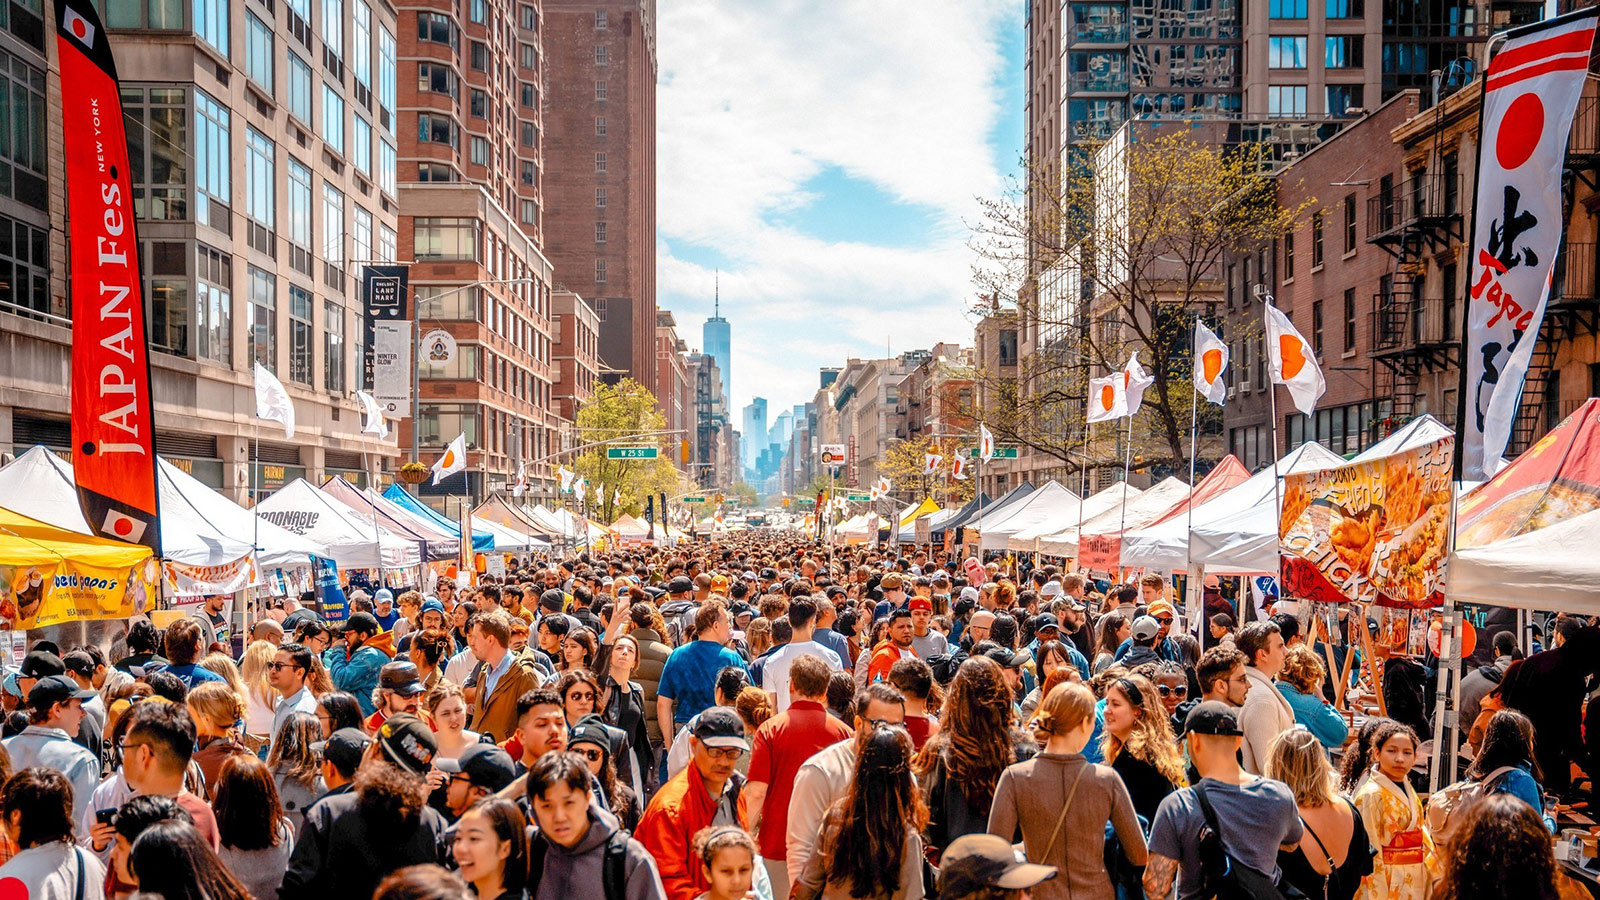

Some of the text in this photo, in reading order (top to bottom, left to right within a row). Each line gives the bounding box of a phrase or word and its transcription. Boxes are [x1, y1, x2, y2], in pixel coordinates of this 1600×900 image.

[91, 98, 105, 173] NEW YORK
[98, 281, 146, 457] JAPAN
